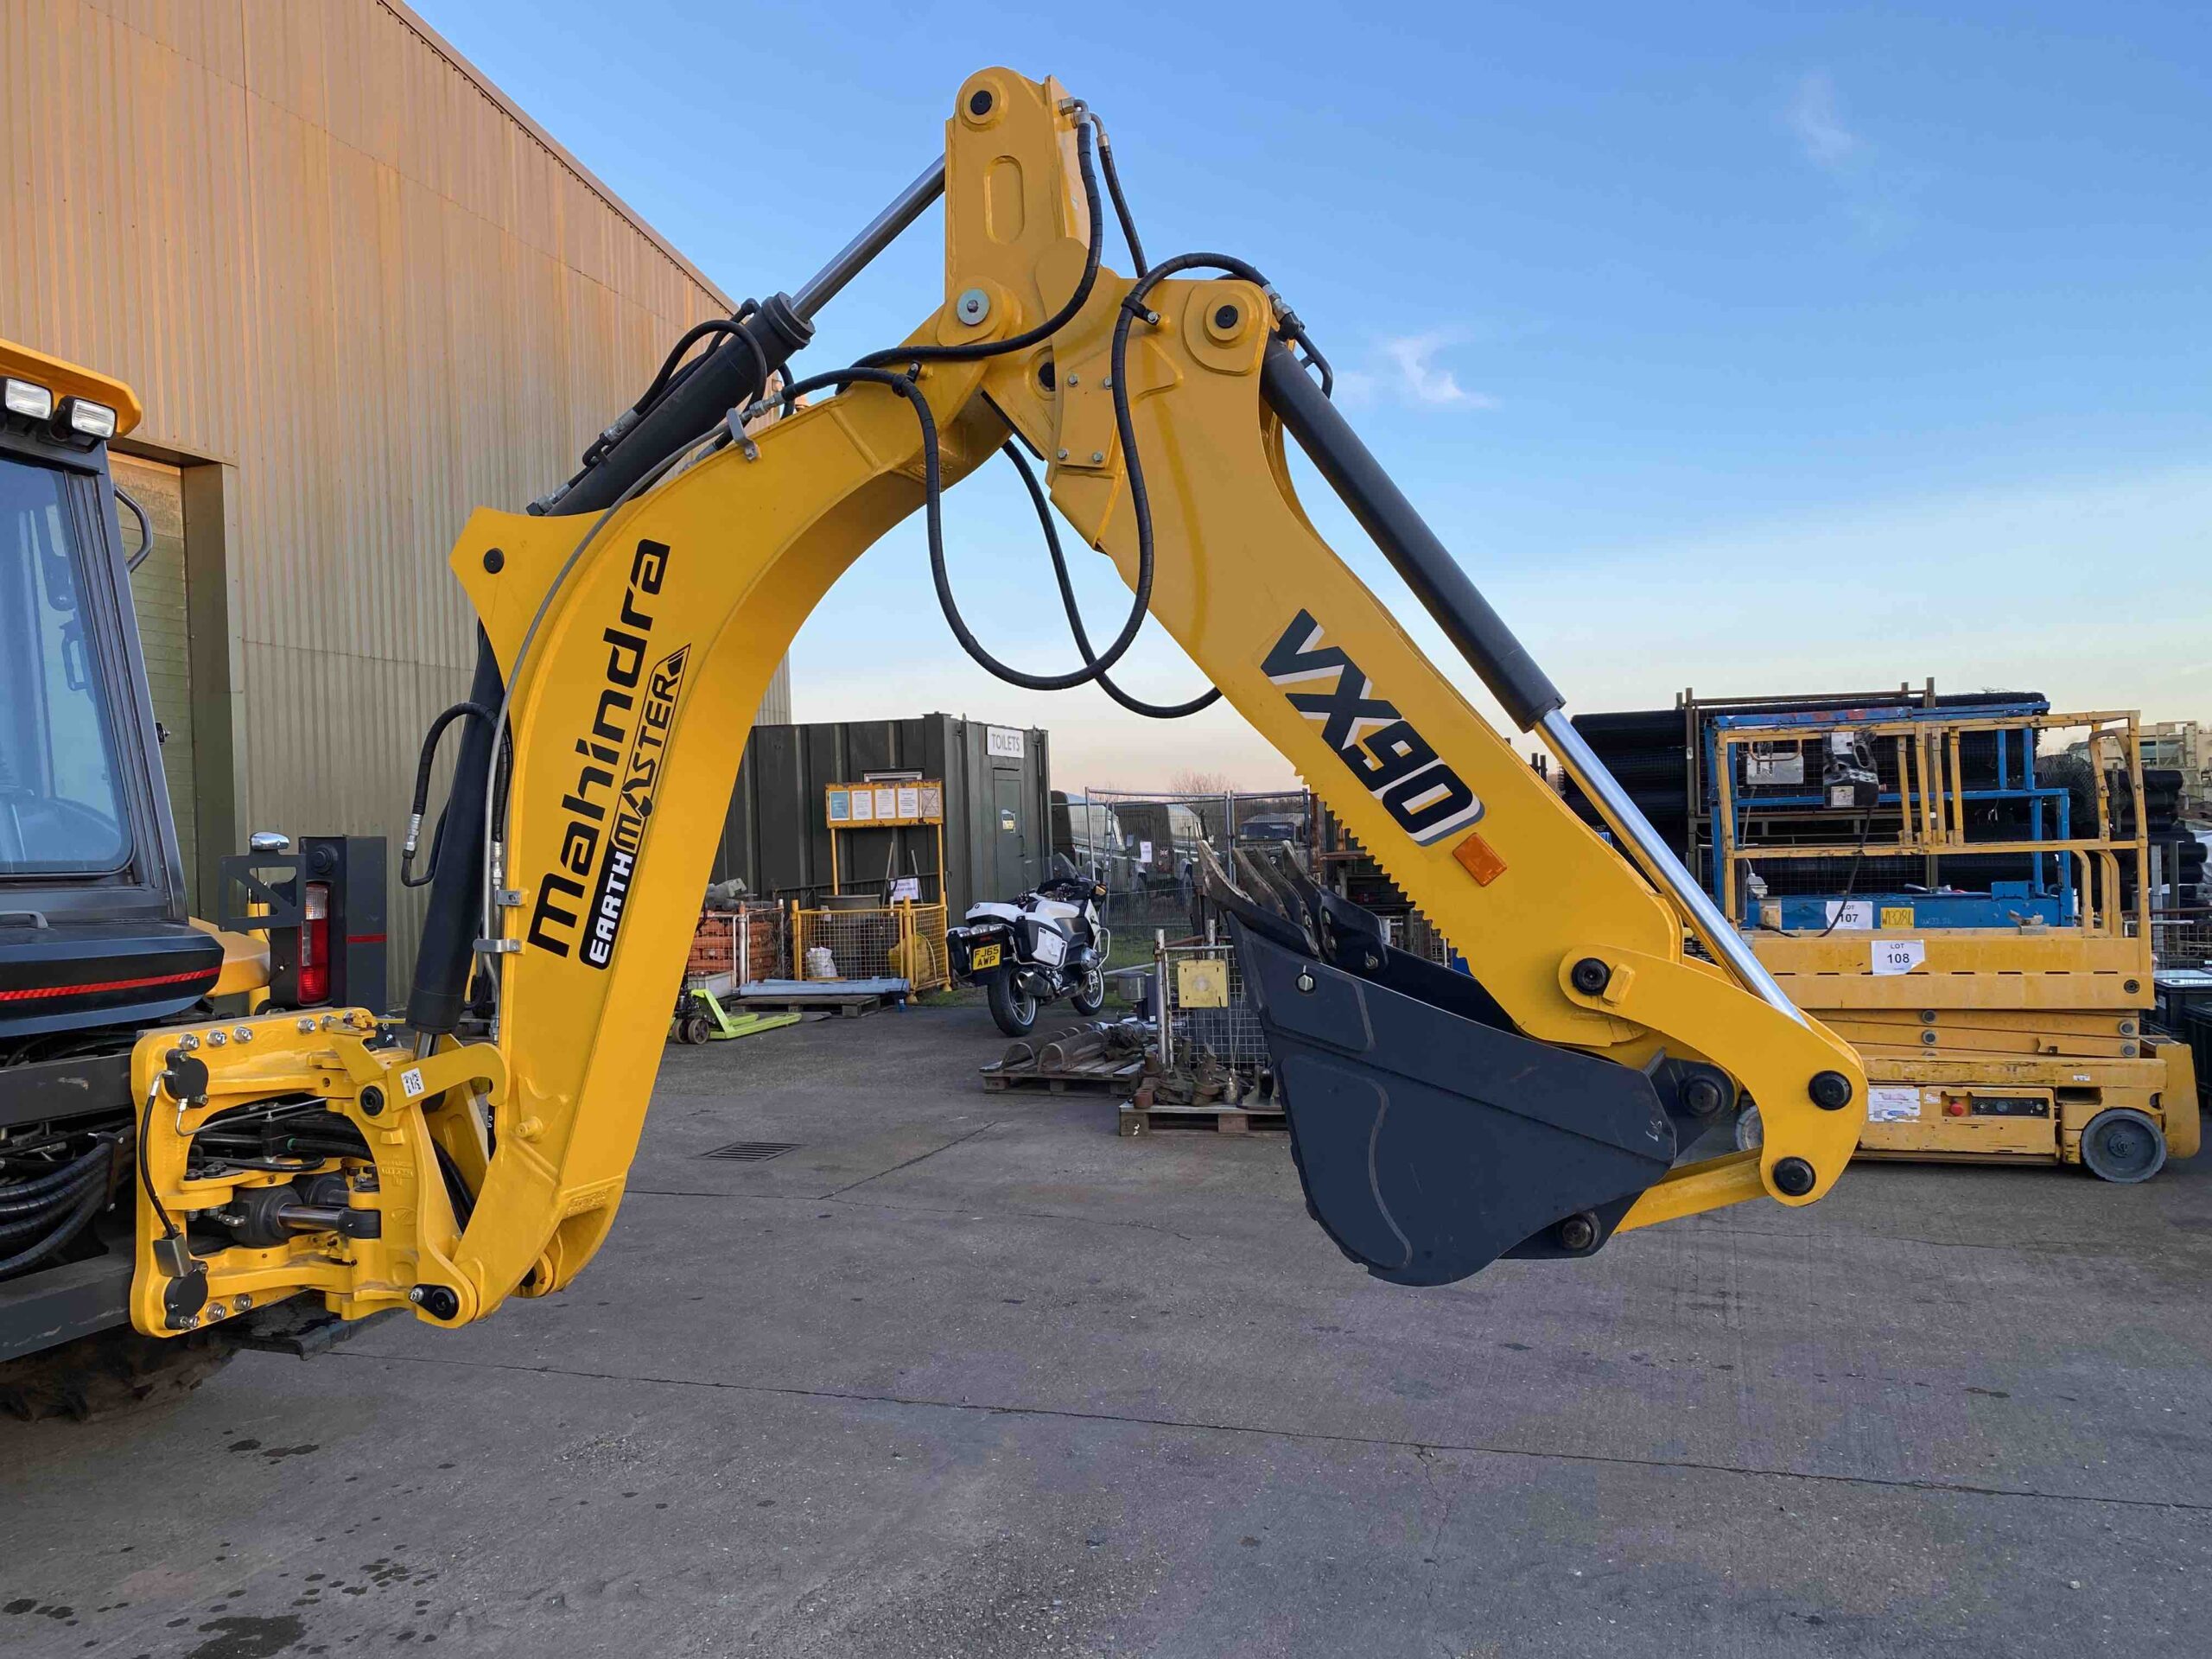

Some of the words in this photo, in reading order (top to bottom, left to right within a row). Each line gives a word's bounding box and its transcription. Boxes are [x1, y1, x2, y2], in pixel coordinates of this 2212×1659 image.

[1260, 607, 1484, 846] VX90
[991, 734, 1020, 752] TOILETS
[1839, 913, 1859, 923] 107
[974, 945, 1000, 959] FJ65
[1887, 953, 1910, 963] 108
[976, 955, 996, 968] AWP
